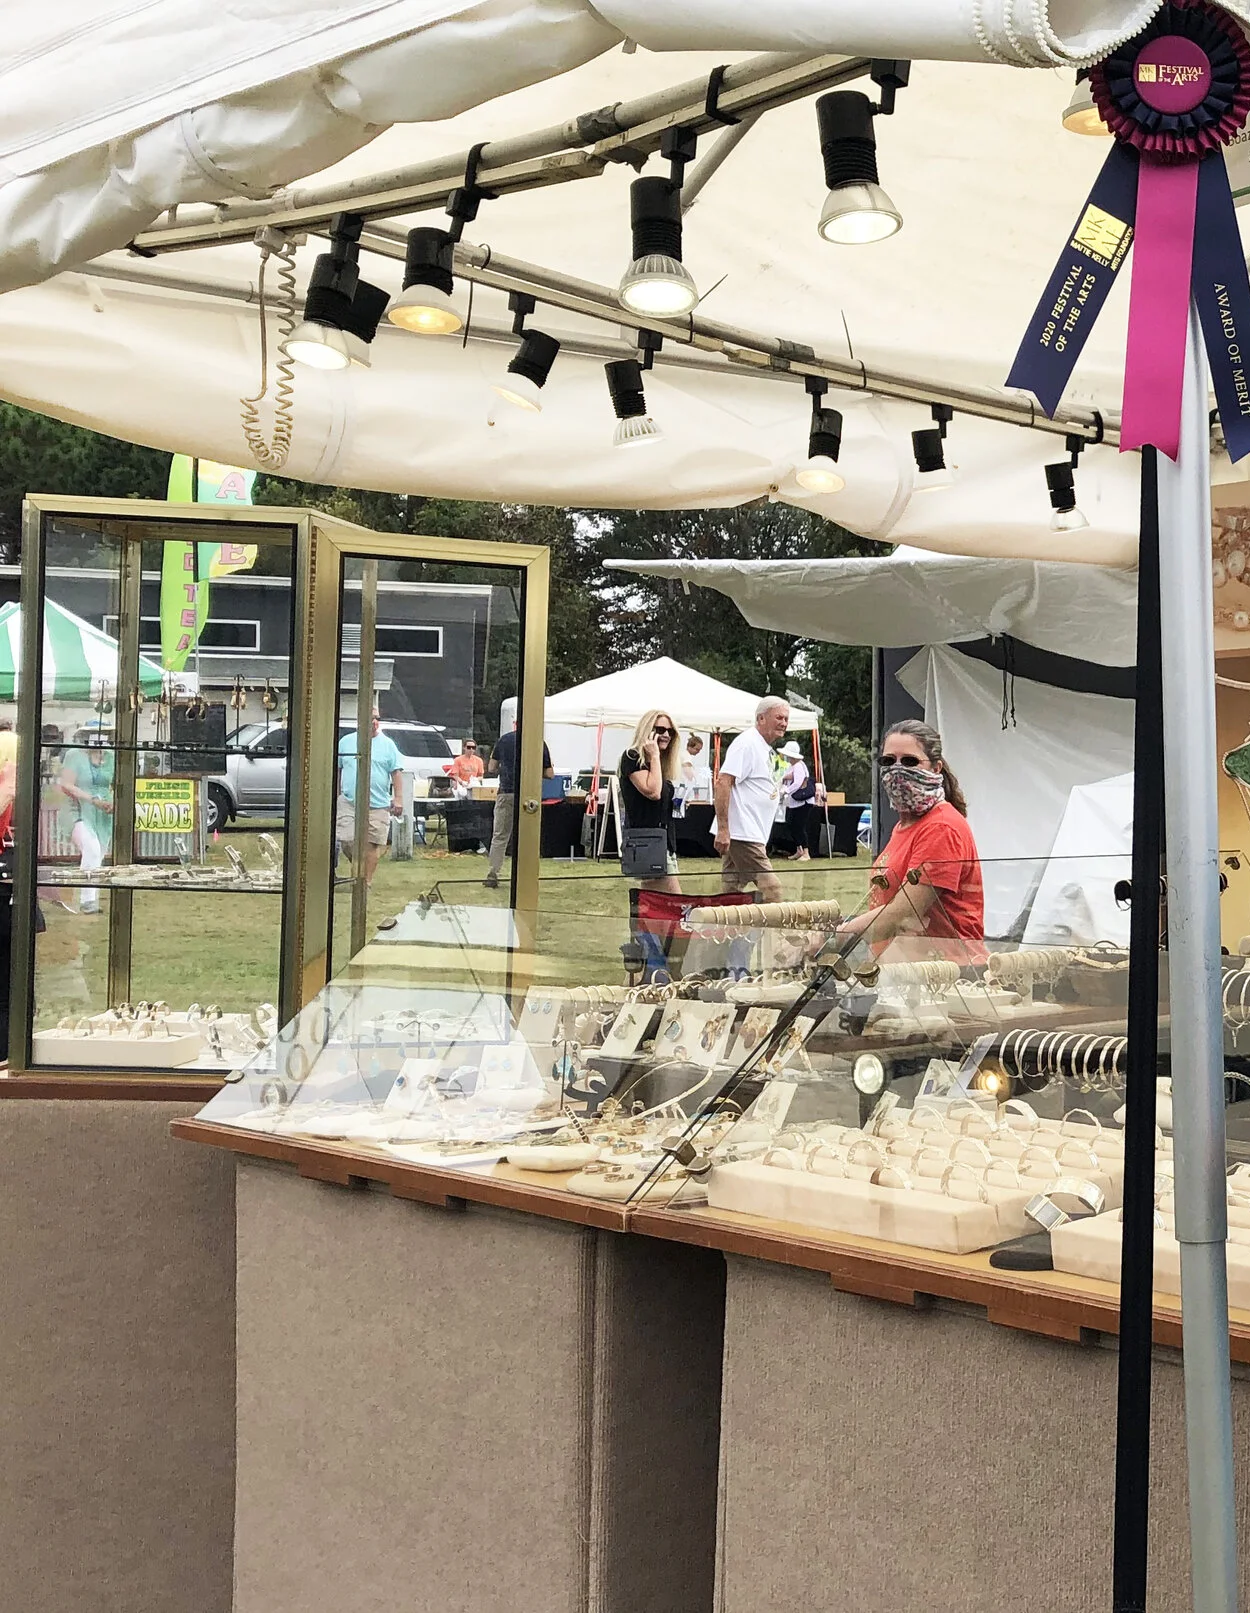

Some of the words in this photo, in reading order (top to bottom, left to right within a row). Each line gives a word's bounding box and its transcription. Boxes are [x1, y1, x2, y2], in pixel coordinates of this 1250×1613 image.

[1158, 64, 1205, 78] FESTIVAL
[1171, 72, 1199, 86] ARTS
[1070, 239, 1093, 258] MATTIE
[1091, 252, 1111, 268] KELLY
[1039, 321, 1057, 348] 2020
[1051, 263, 1084, 320] FESTIVAL
[1055, 334, 1069, 353] OF
[1063, 306, 1081, 333] THE
[1075, 273, 1097, 306] ARTS
[1213, 282, 1237, 339] AWARD
[1227, 343, 1242, 364] OF
[135, 802, 192, 829] NADE
